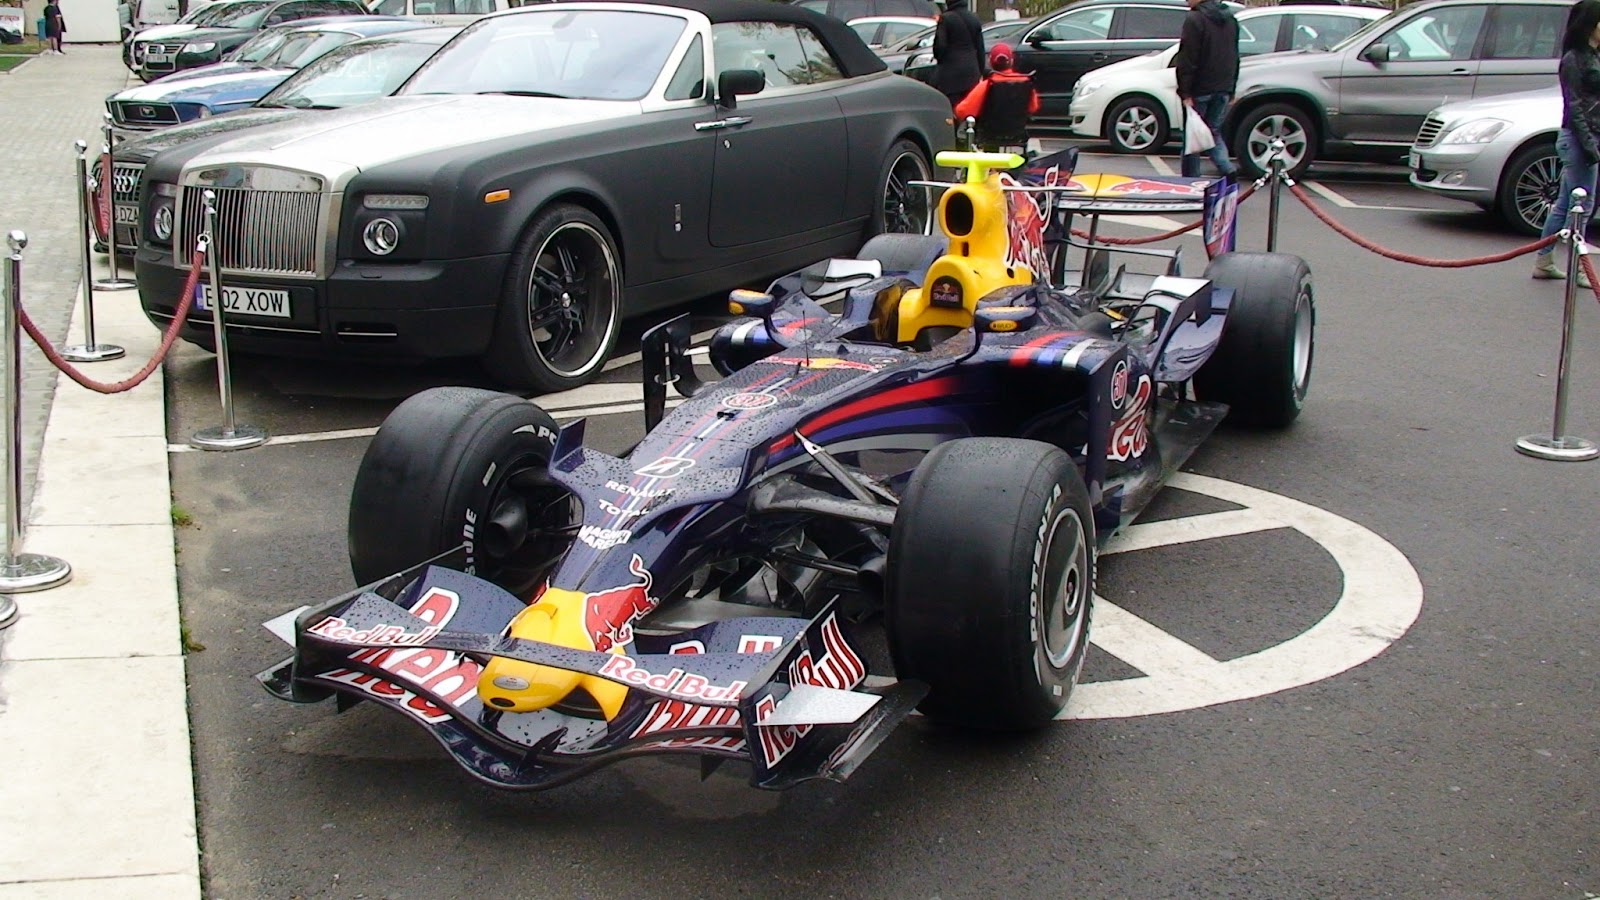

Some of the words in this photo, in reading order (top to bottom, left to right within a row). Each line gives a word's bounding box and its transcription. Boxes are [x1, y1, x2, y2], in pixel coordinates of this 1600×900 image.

[245, 290, 283, 313] XOW
[604, 480, 676, 498] RENAULT
[598, 498, 650, 518] TOTAL
[1030, 483, 1062, 642] POTENZA
